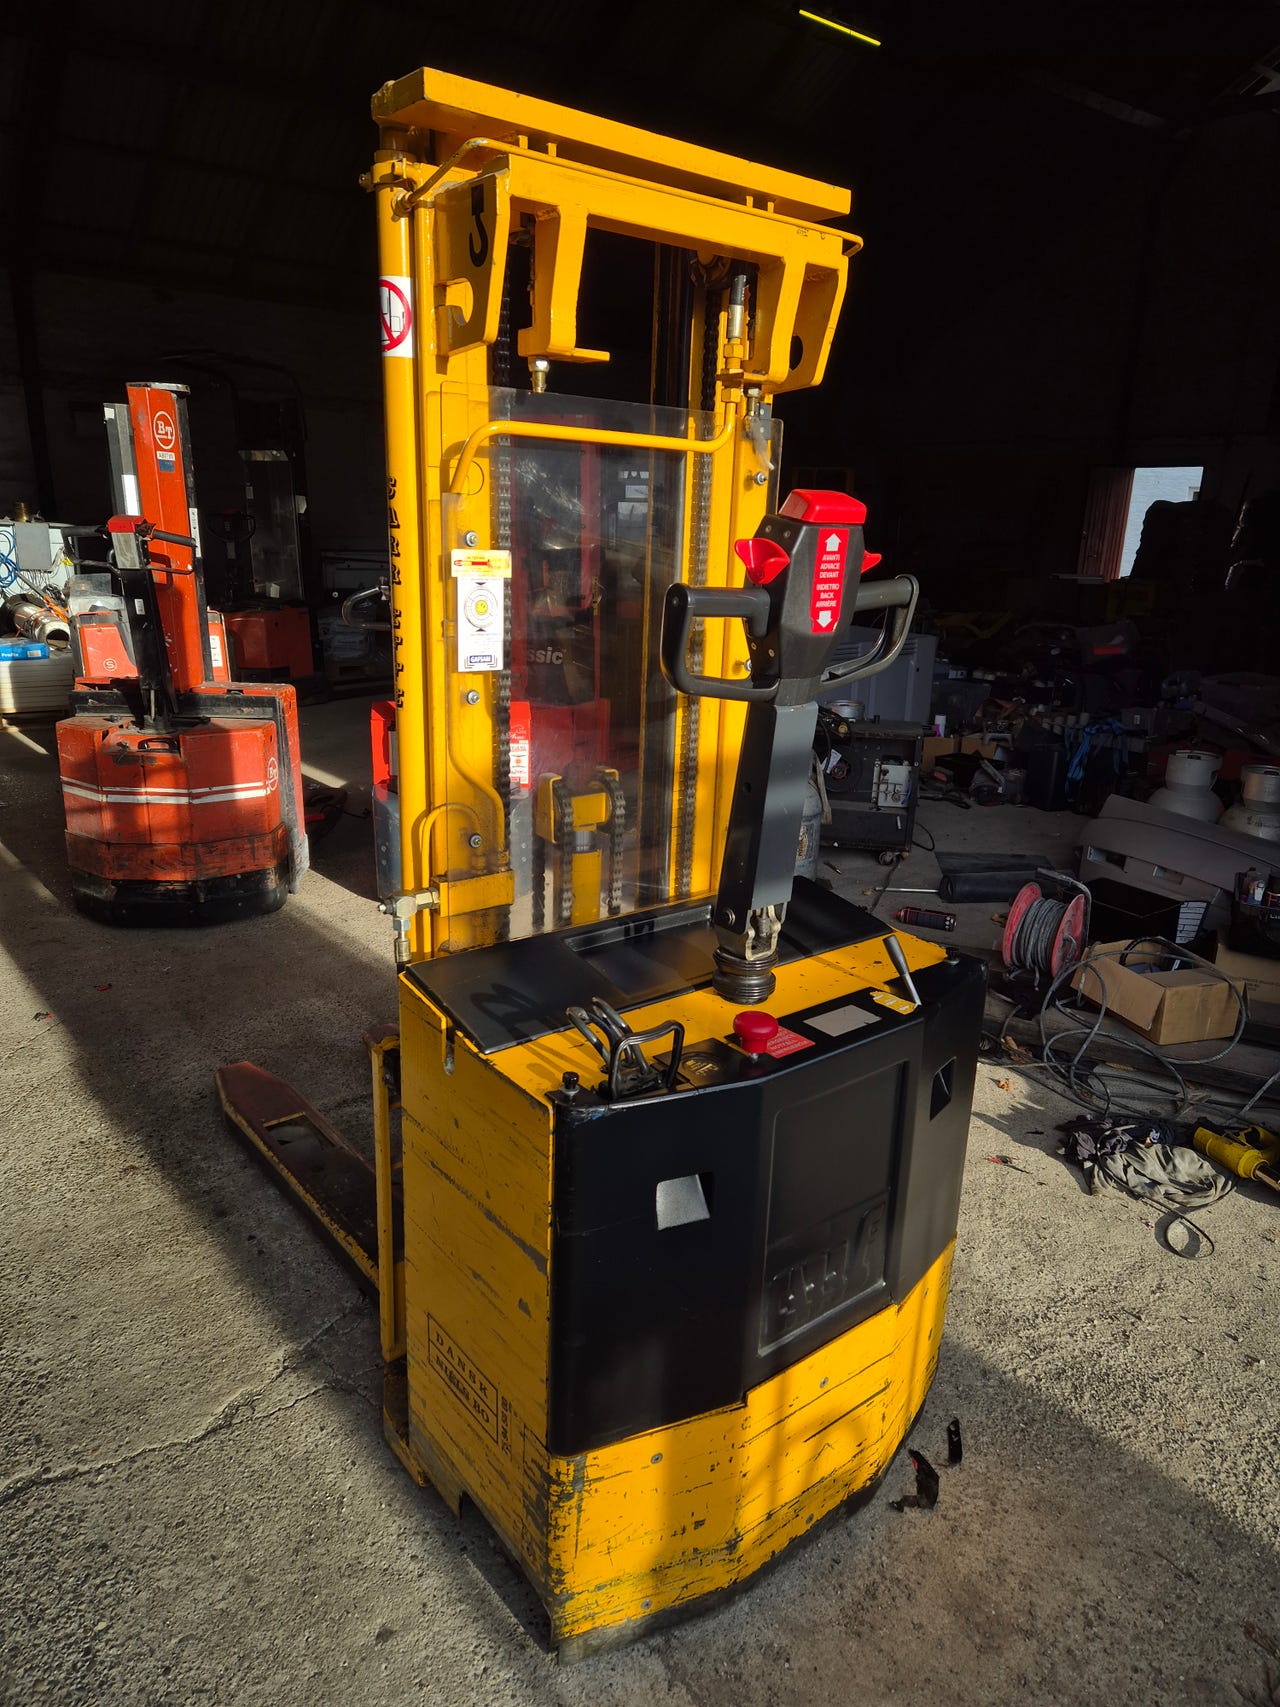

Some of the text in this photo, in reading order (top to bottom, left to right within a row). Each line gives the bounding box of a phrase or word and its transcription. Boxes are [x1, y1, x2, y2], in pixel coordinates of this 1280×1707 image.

[157, 420, 173, 439] BT
[819, 571, 839, 579] DEVANT
[816, 583, 840, 591] INDIETRO
[436, 1330, 489, 1400] DANSK
